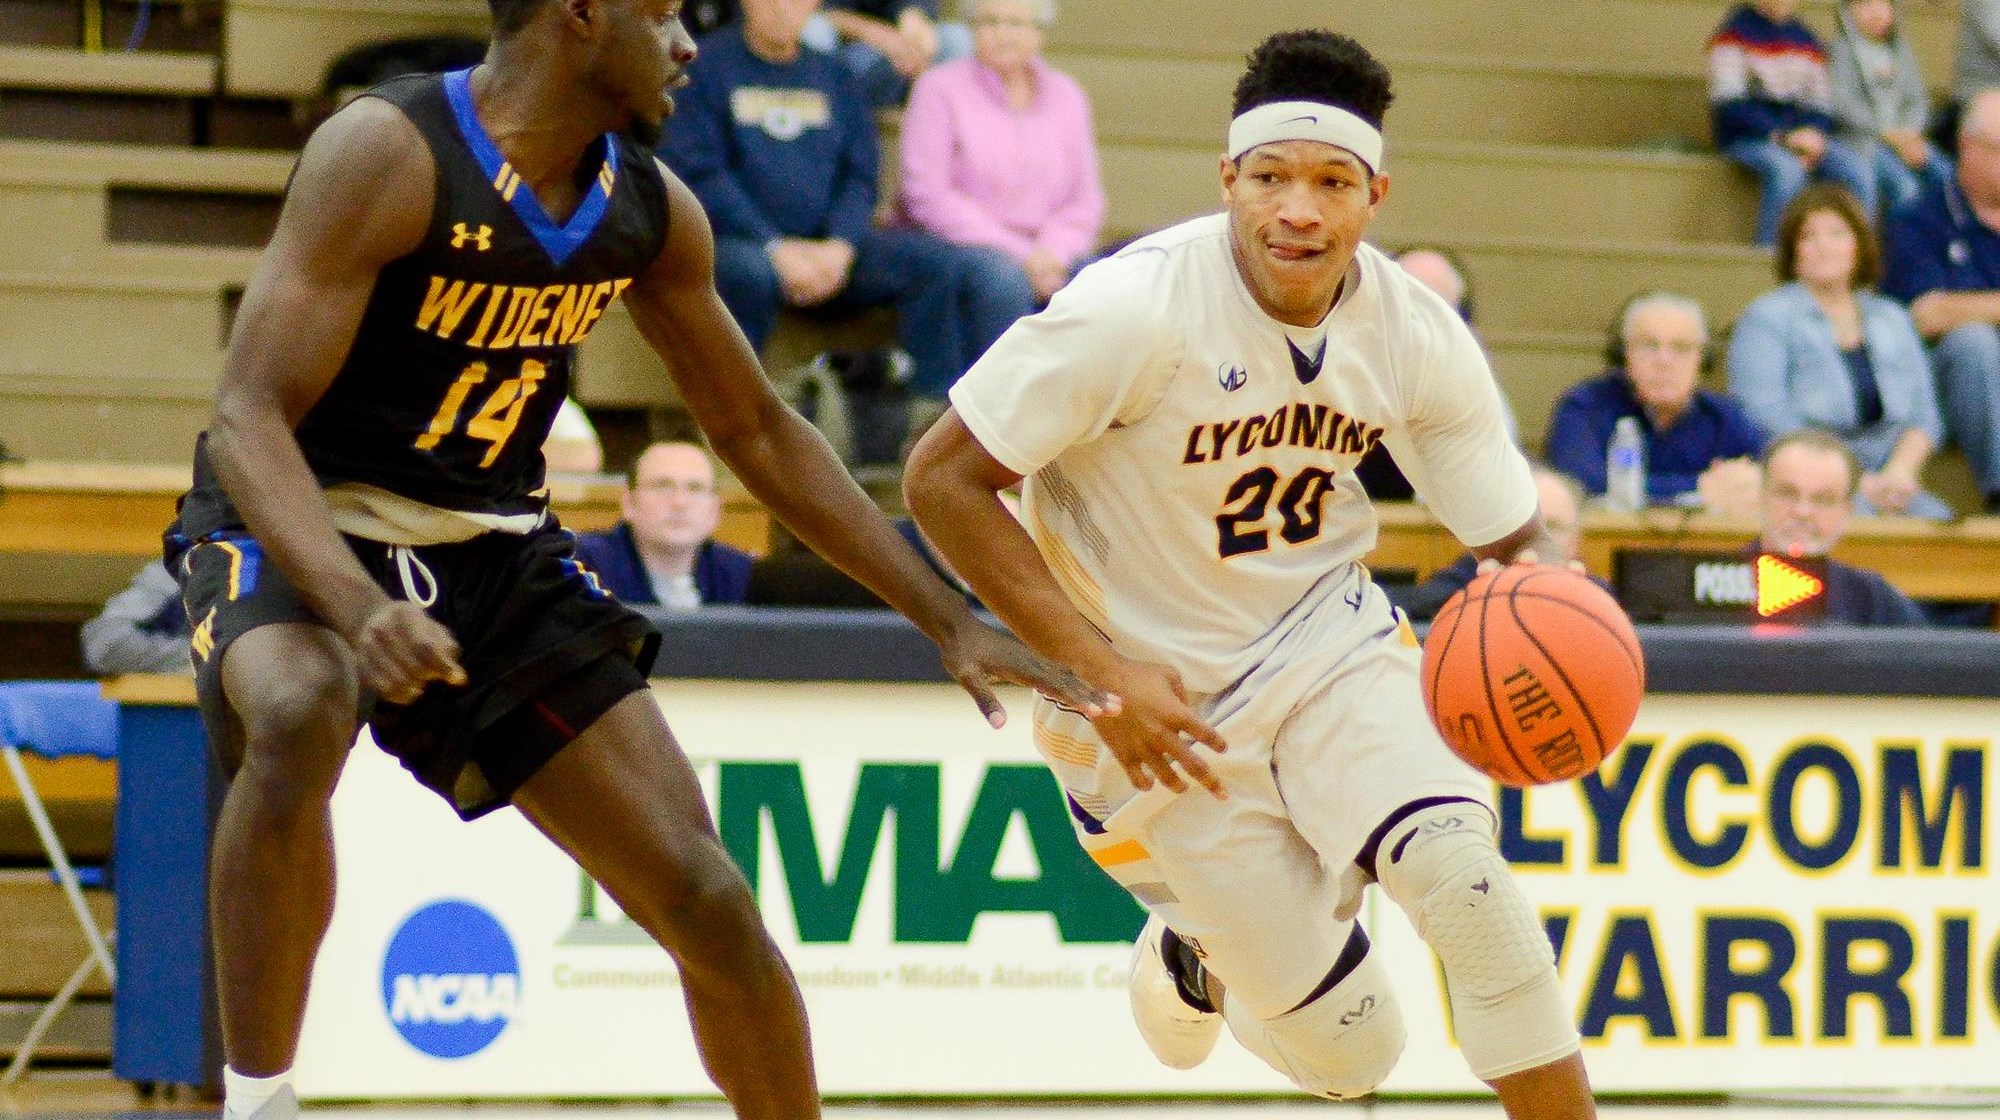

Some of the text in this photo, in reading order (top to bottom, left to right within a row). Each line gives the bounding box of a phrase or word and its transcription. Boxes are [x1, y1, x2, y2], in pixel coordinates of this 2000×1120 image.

[414, 358, 547, 469] 14
[1213, 464, 1336, 560] 20
[1502, 663, 1563, 733] THE
[716, 760, 1150, 945] MA
[1499, 736, 1988, 873] LYCOM
[391, 972, 519, 1023] NCAA
[899, 963, 982, 989] Middle
[990, 963, 1085, 990] Atlantic
[1437, 907, 2000, 1046] ARRI
